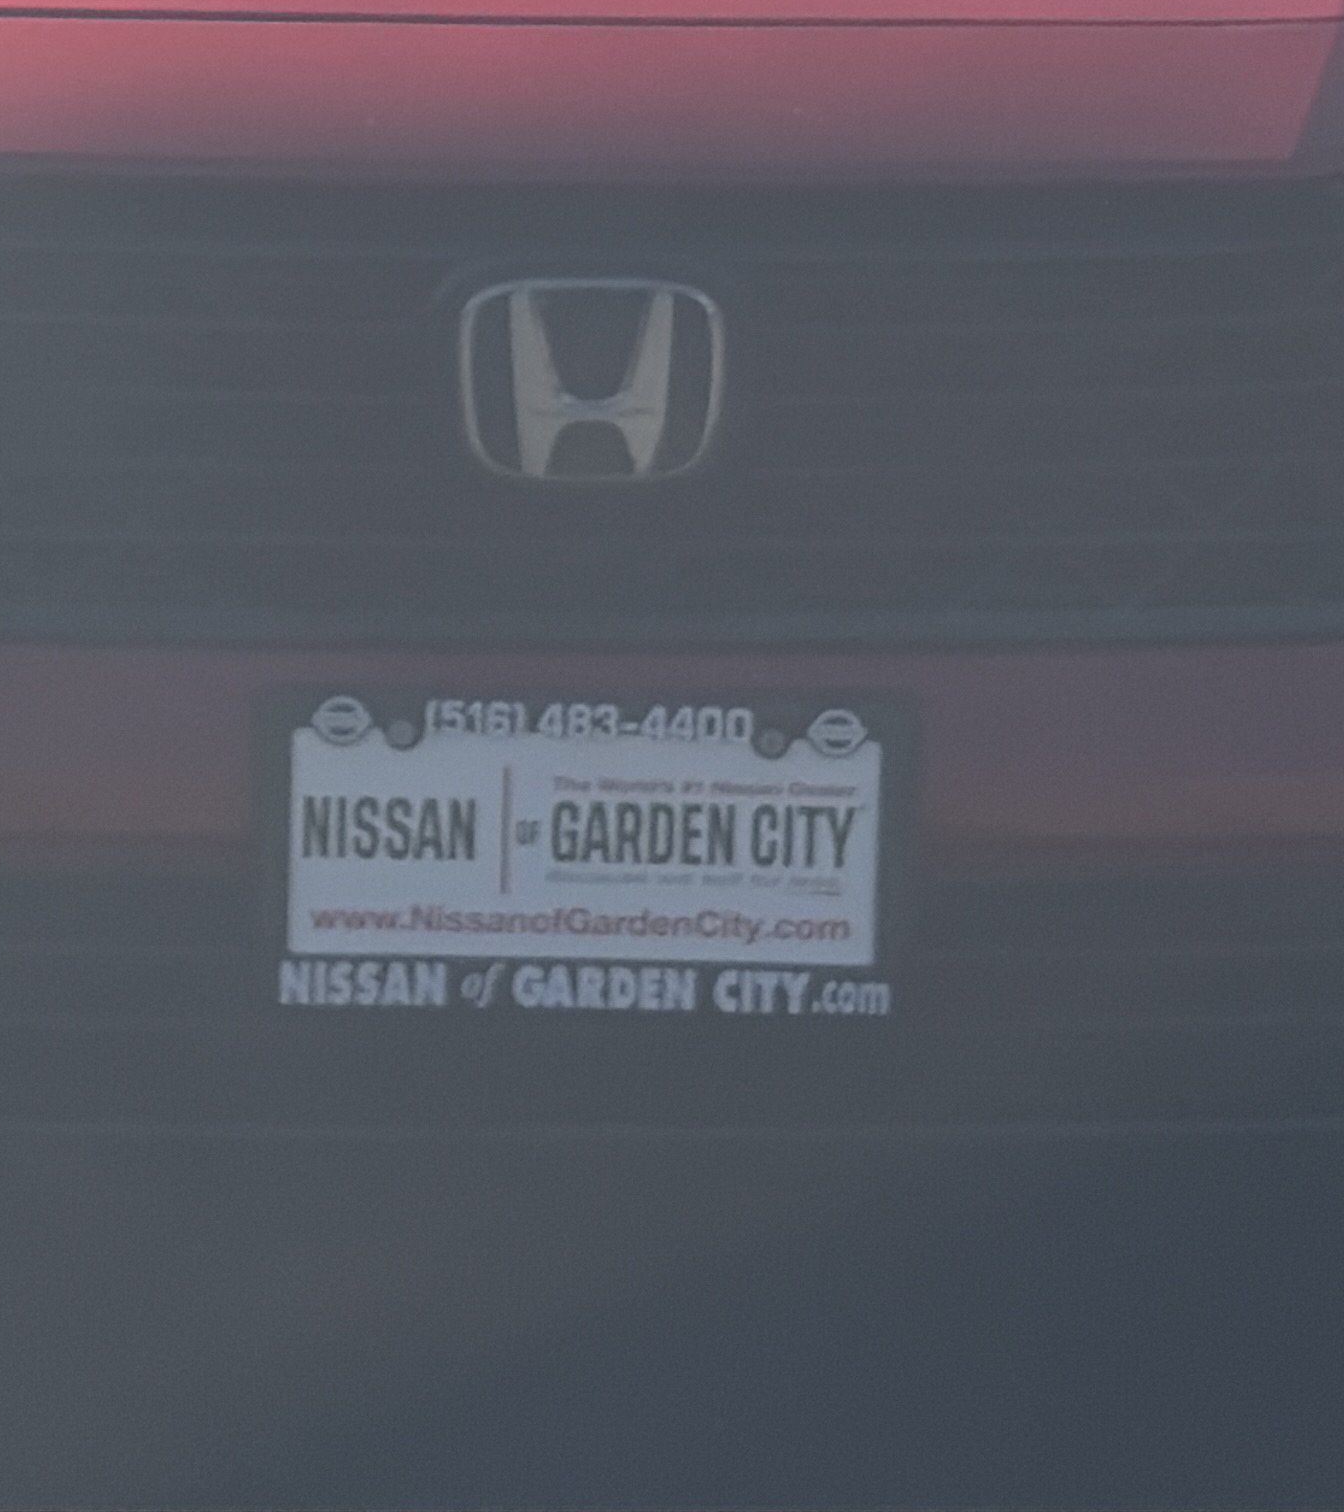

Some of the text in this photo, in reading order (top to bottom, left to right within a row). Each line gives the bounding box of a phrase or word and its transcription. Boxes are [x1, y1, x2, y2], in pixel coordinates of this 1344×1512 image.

[536, 704, 752, 745] 483-4400
[301, 796, 476, 860] NISSAN
[550, 801, 735, 867] GARDEN
[751, 806, 857, 868] CITY
[309, 905, 851, 945] www.NissanofGardenCity.com
[279, 960, 891, 1015] NISSAN of GARDEN CITY.com
